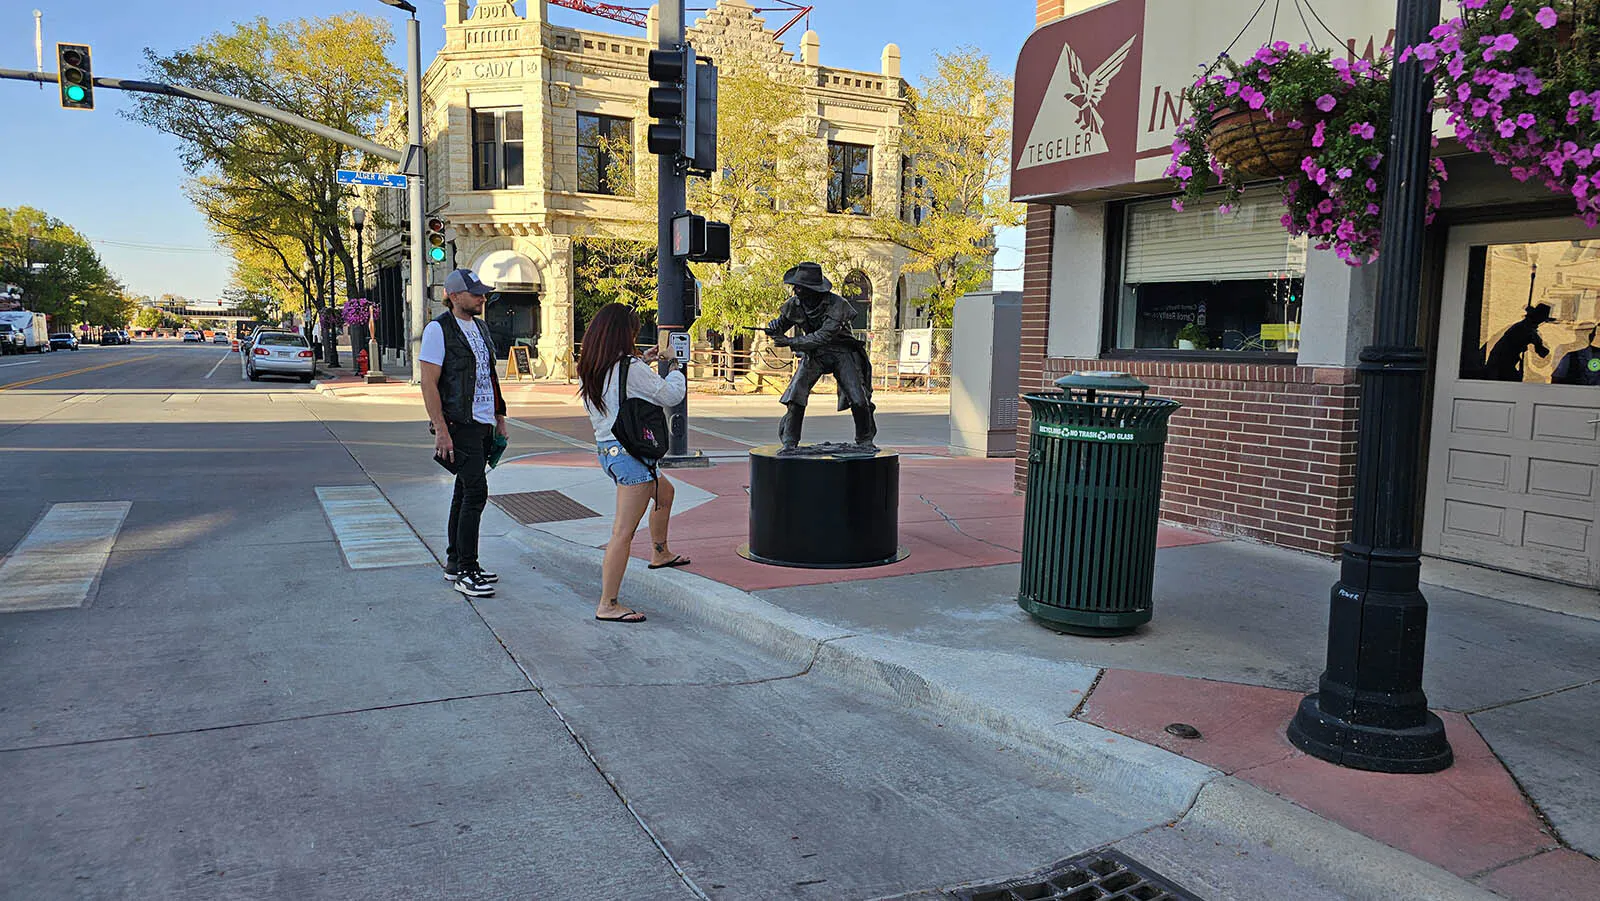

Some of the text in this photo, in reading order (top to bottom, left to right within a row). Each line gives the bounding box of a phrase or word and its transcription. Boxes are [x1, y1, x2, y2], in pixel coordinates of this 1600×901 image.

[474, 61, 513, 78] CADY
[1148, 83, 1192, 132] IN
[1028, 132, 1092, 164] TEGELER
[377, 173, 390, 182] AVE
[910, 341, 920, 356] D
[1039, 425, 1061, 435] RECYCLING
[1069, 430, 1078, 438] NO
[1079, 430, 1097, 439] TRASH
[1107, 432, 1115, 440] NO
